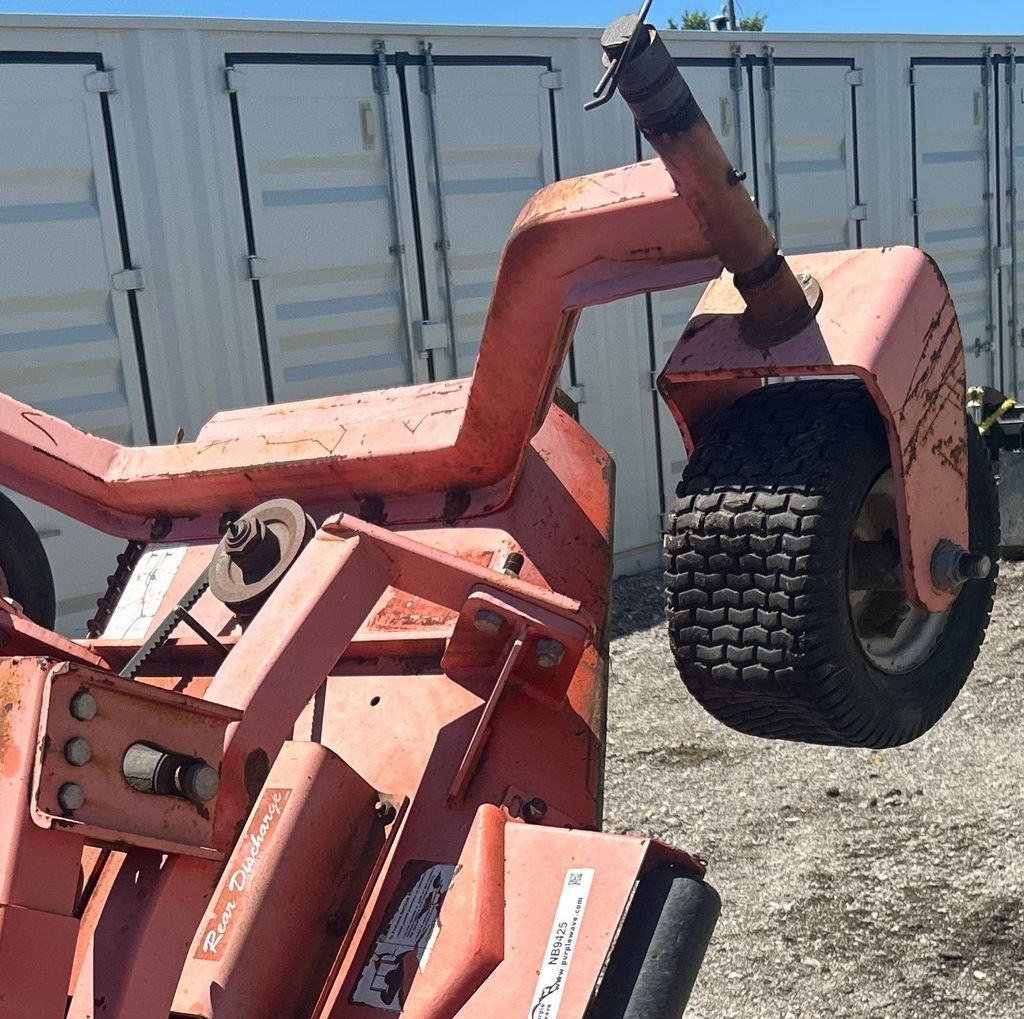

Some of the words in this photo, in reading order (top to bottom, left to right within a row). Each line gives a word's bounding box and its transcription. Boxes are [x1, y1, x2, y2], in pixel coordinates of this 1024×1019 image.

[202, 900, 237, 953] Rear
[228, 791, 283, 892] Discharge
[547, 921, 568, 965] NB9425
